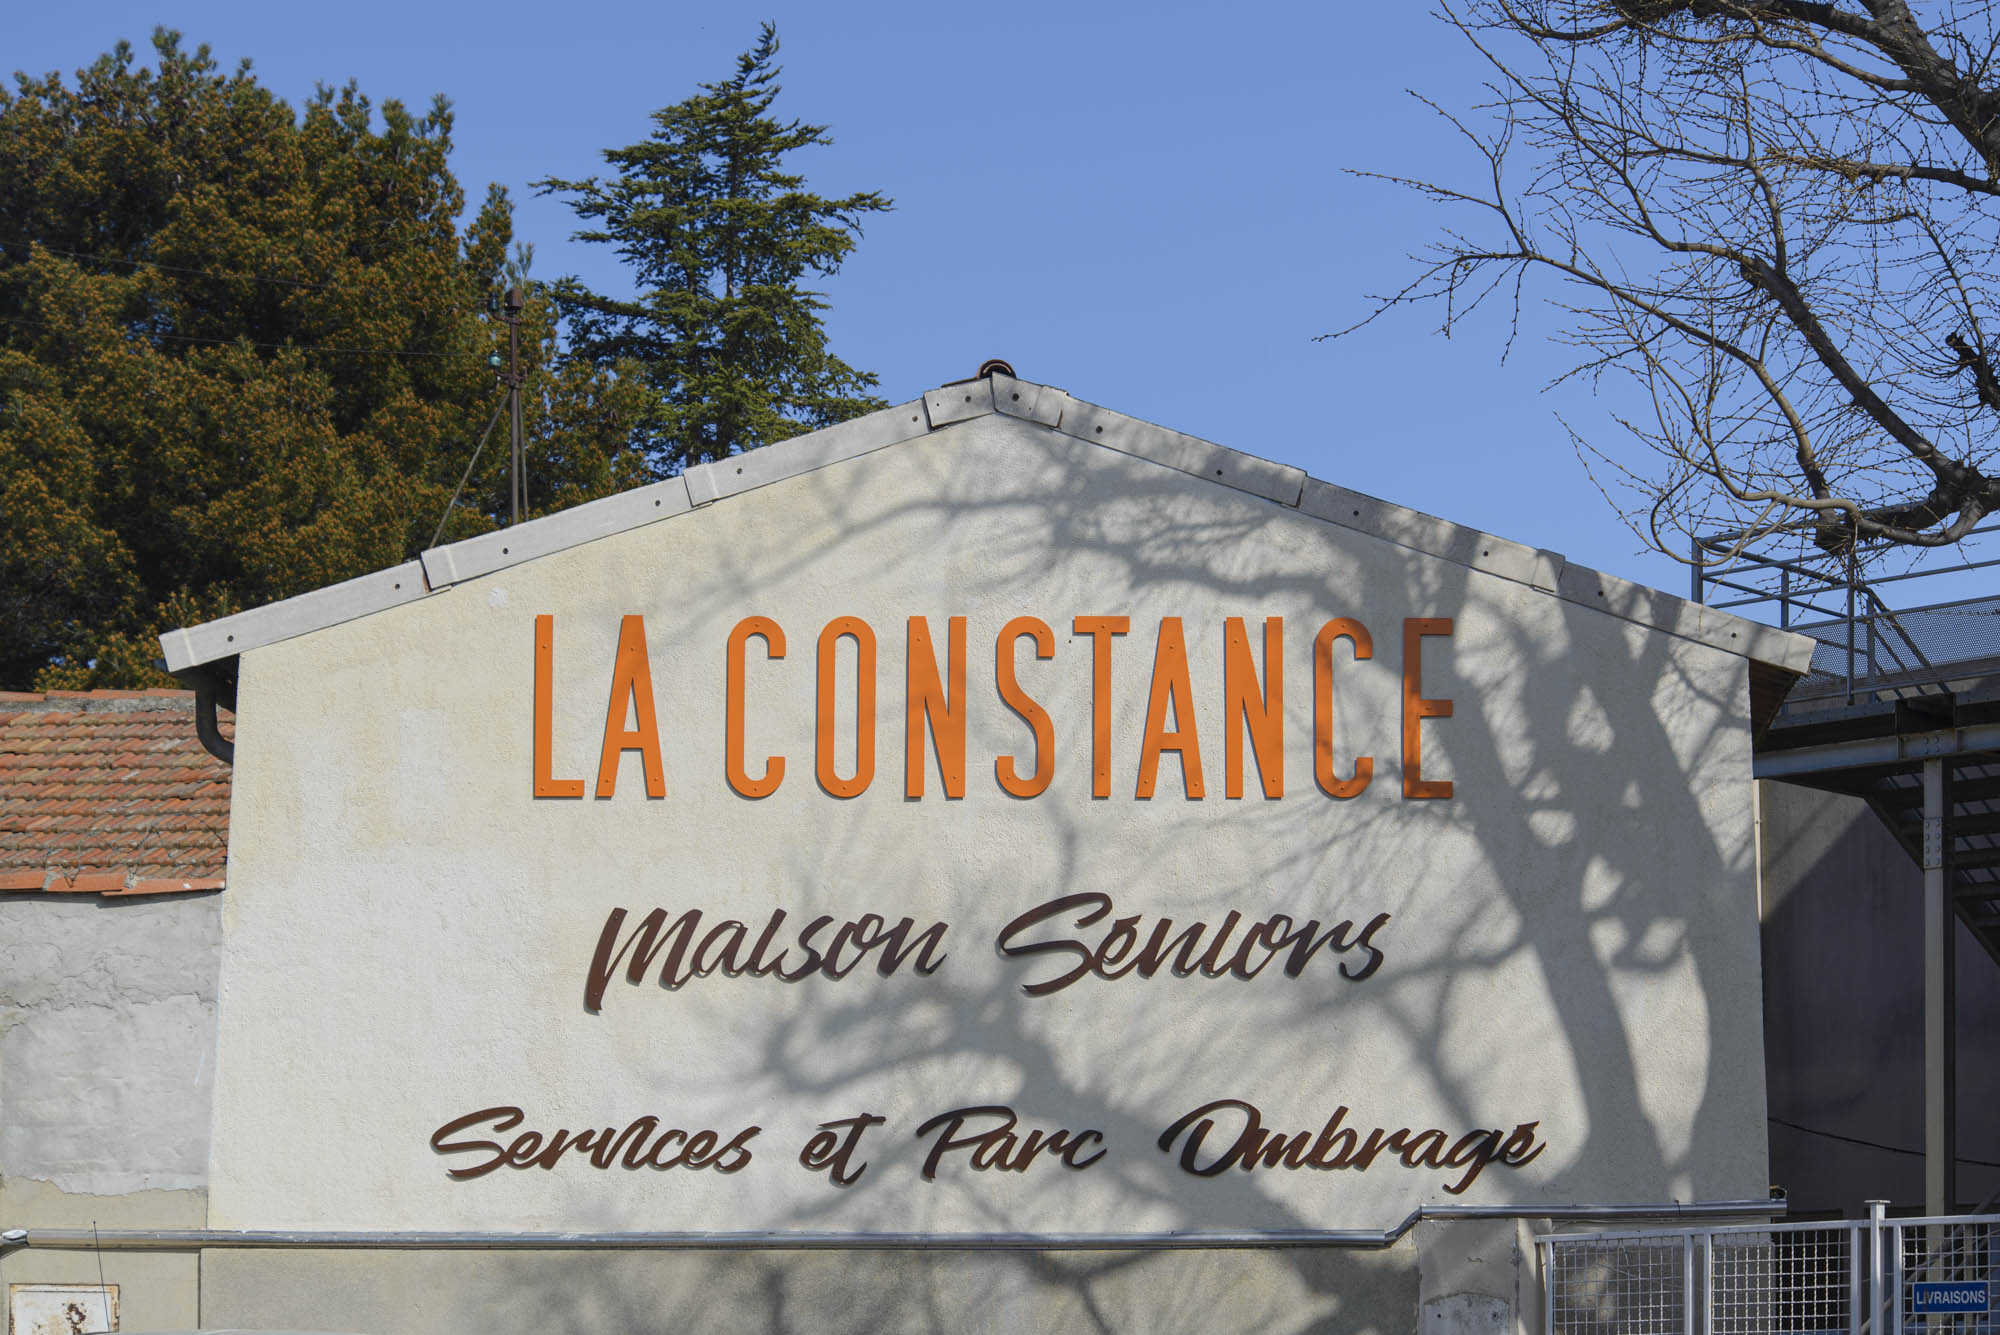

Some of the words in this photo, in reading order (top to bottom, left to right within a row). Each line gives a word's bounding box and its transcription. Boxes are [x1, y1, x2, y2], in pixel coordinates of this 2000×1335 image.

[533, 614, 667, 800] LA
[725, 614, 1454, 801] CONSTANCE
[585, 906, 948, 1015] Maison
[430, 1105, 762, 1178] Services
[799, 1111, 887, 1186] et
[914, 1104, 1108, 1181] Parc
[1156, 1098, 1547, 1195] Ombragé
[1916, 1290, 1986, 1304] LIVRAISONS
